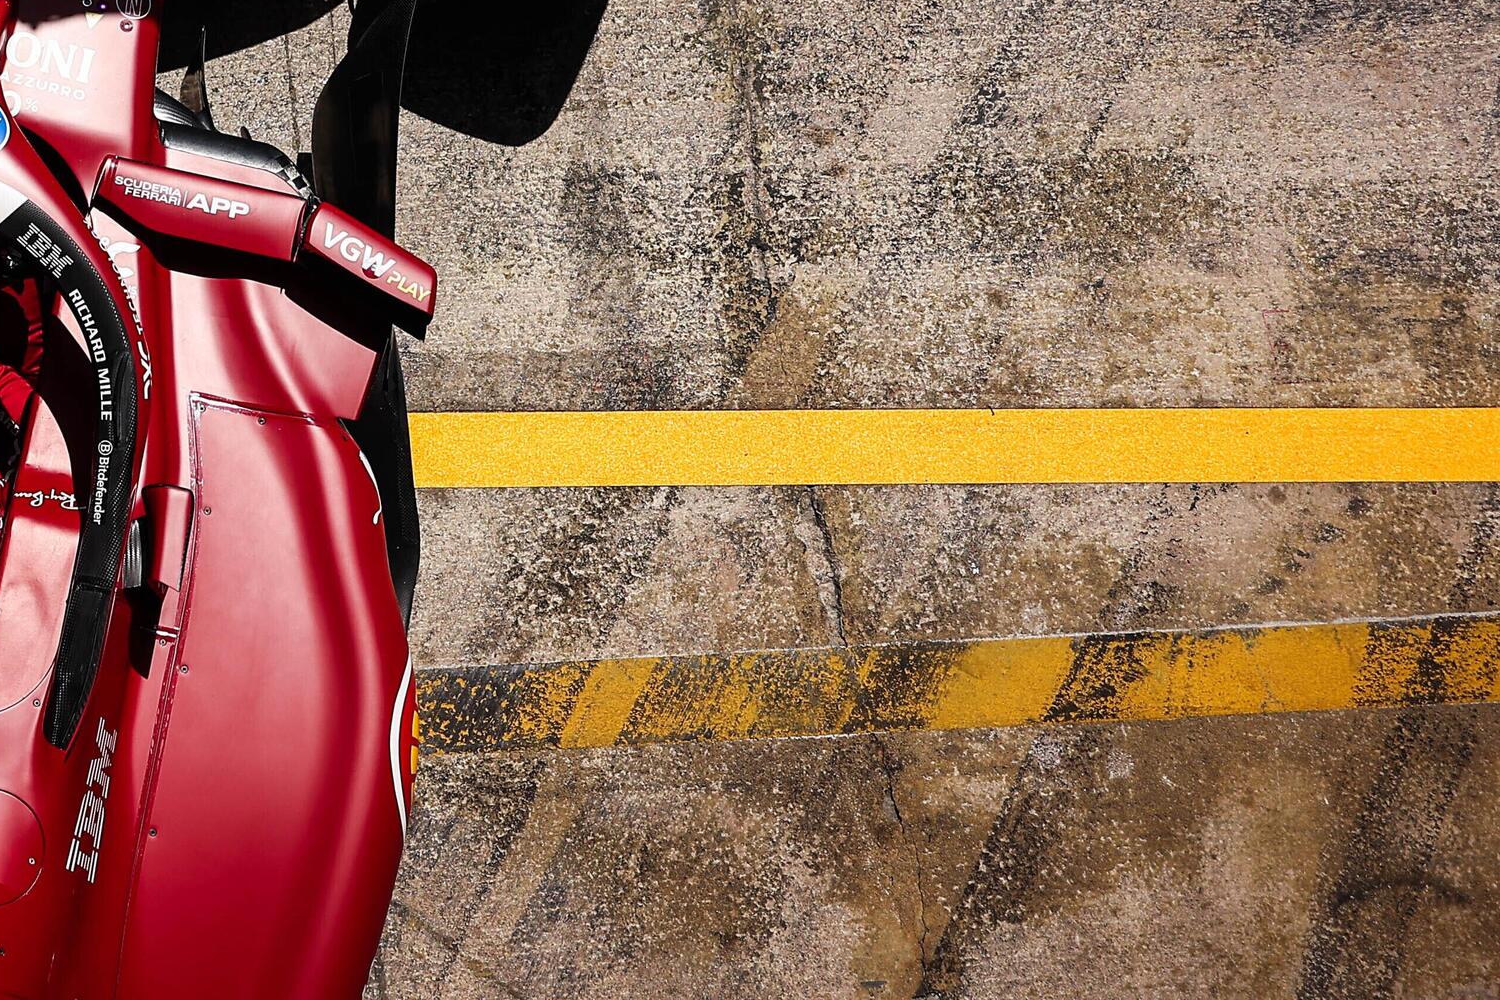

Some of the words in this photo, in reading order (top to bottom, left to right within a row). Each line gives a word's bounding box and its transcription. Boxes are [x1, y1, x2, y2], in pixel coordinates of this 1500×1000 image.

[0, 71, 86, 101] AZZURRO
[114, 175, 182, 197] SCUDERIA
[124, 186, 181, 207] FERRARI
[187, 192, 250, 218] APP
[16, 223, 74, 279] IBM
[322, 221, 397, 279] VGW
[386, 269, 432, 302] PLAY
[69, 289, 106, 363] RICHARD
[98, 368, 113, 421] MILLE
[15, 491, 87, 510] Ray-Ban
[94, 456, 112, 526] Bitdefender
[66, 717, 119, 883] IBM
